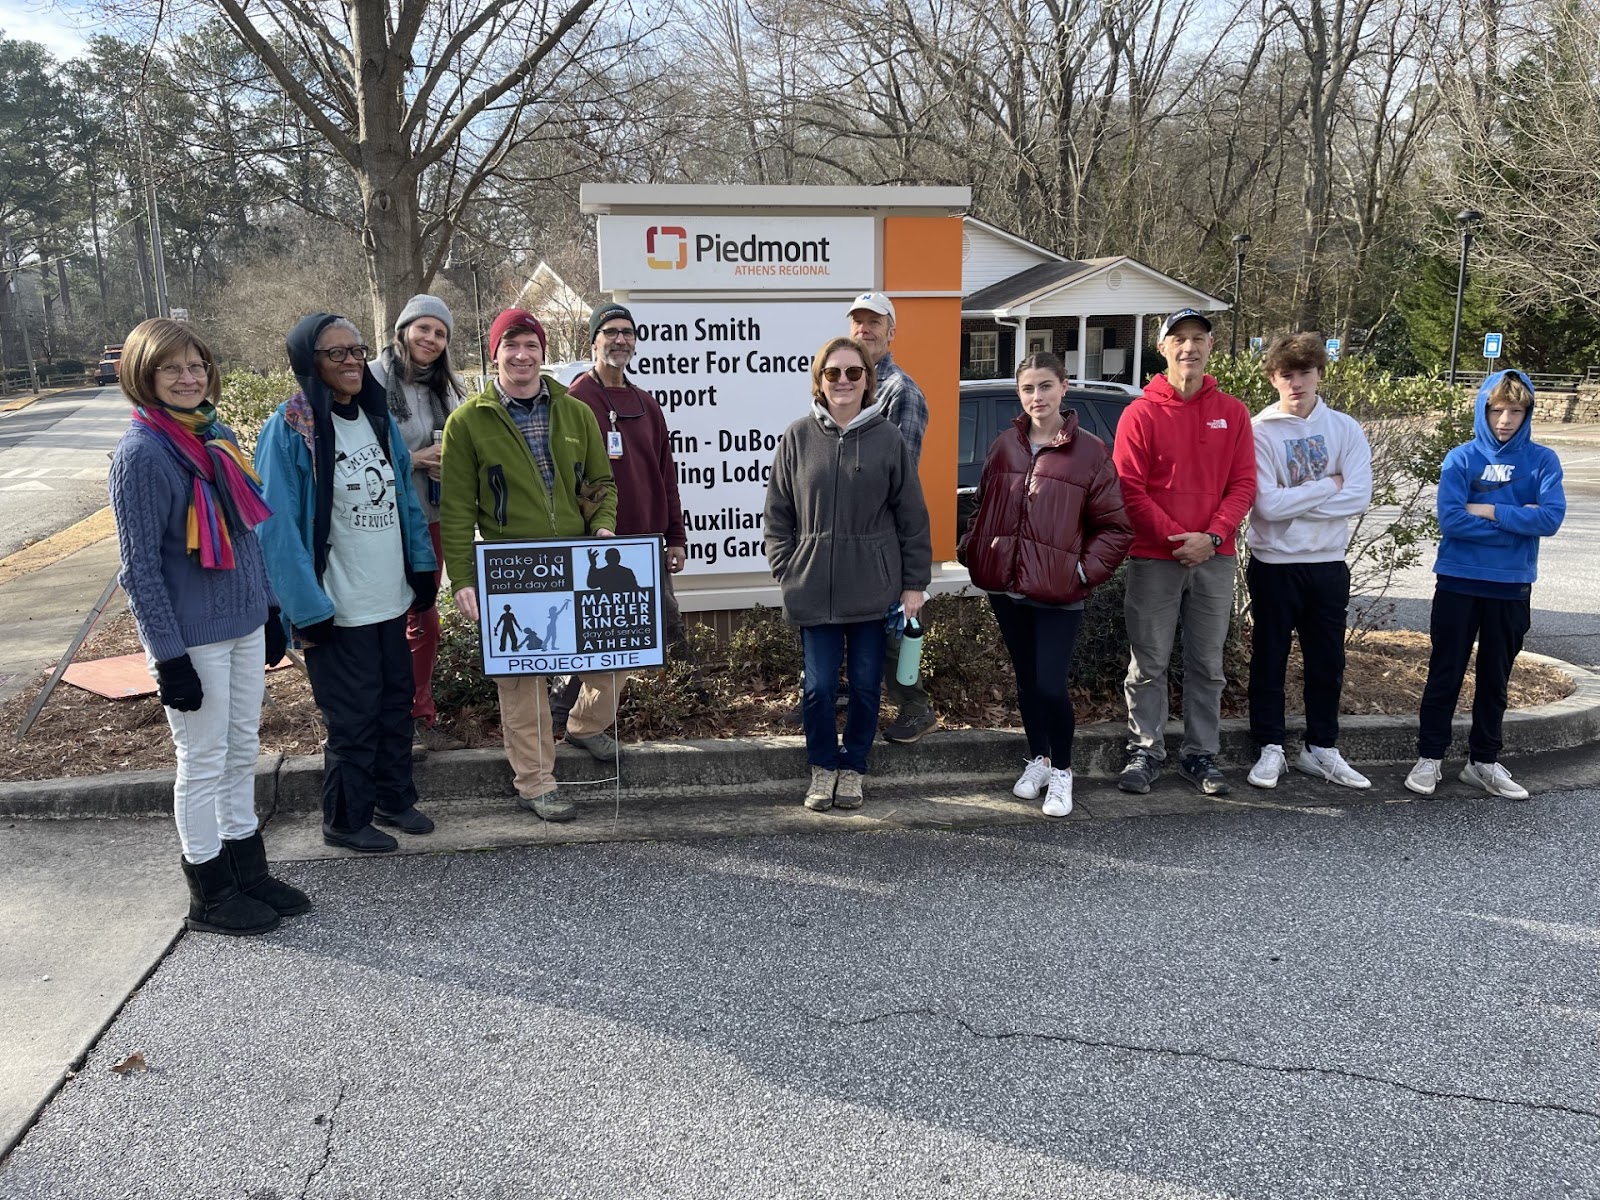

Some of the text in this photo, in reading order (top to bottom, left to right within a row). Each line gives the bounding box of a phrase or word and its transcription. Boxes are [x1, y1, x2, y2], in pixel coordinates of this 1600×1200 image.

[696, 234, 830, 262] Piedmont
[735, 265, 830, 276] ATHENS REGIONAL
[637, 317, 760, 341] oran Smith
[706, 350, 740, 373] For
[723, 459, 773, 487] Lodg
[1480, 464, 1516, 482] NIKE
[354, 512, 395, 528] SERVICE
[683, 507, 765, 531] Auxiliar
[489, 554, 564, 566] make it a
[489, 564, 565, 580] day ON
[492, 579, 565, 590] not a day off
[581, 591, 649, 606] MARTIN
[582, 603, 649, 618] LUTHER
[582, 627, 651, 639] day of service
[583, 636, 652, 650] ATHENS
[508, 652, 640, 671] PROJECT SITE
